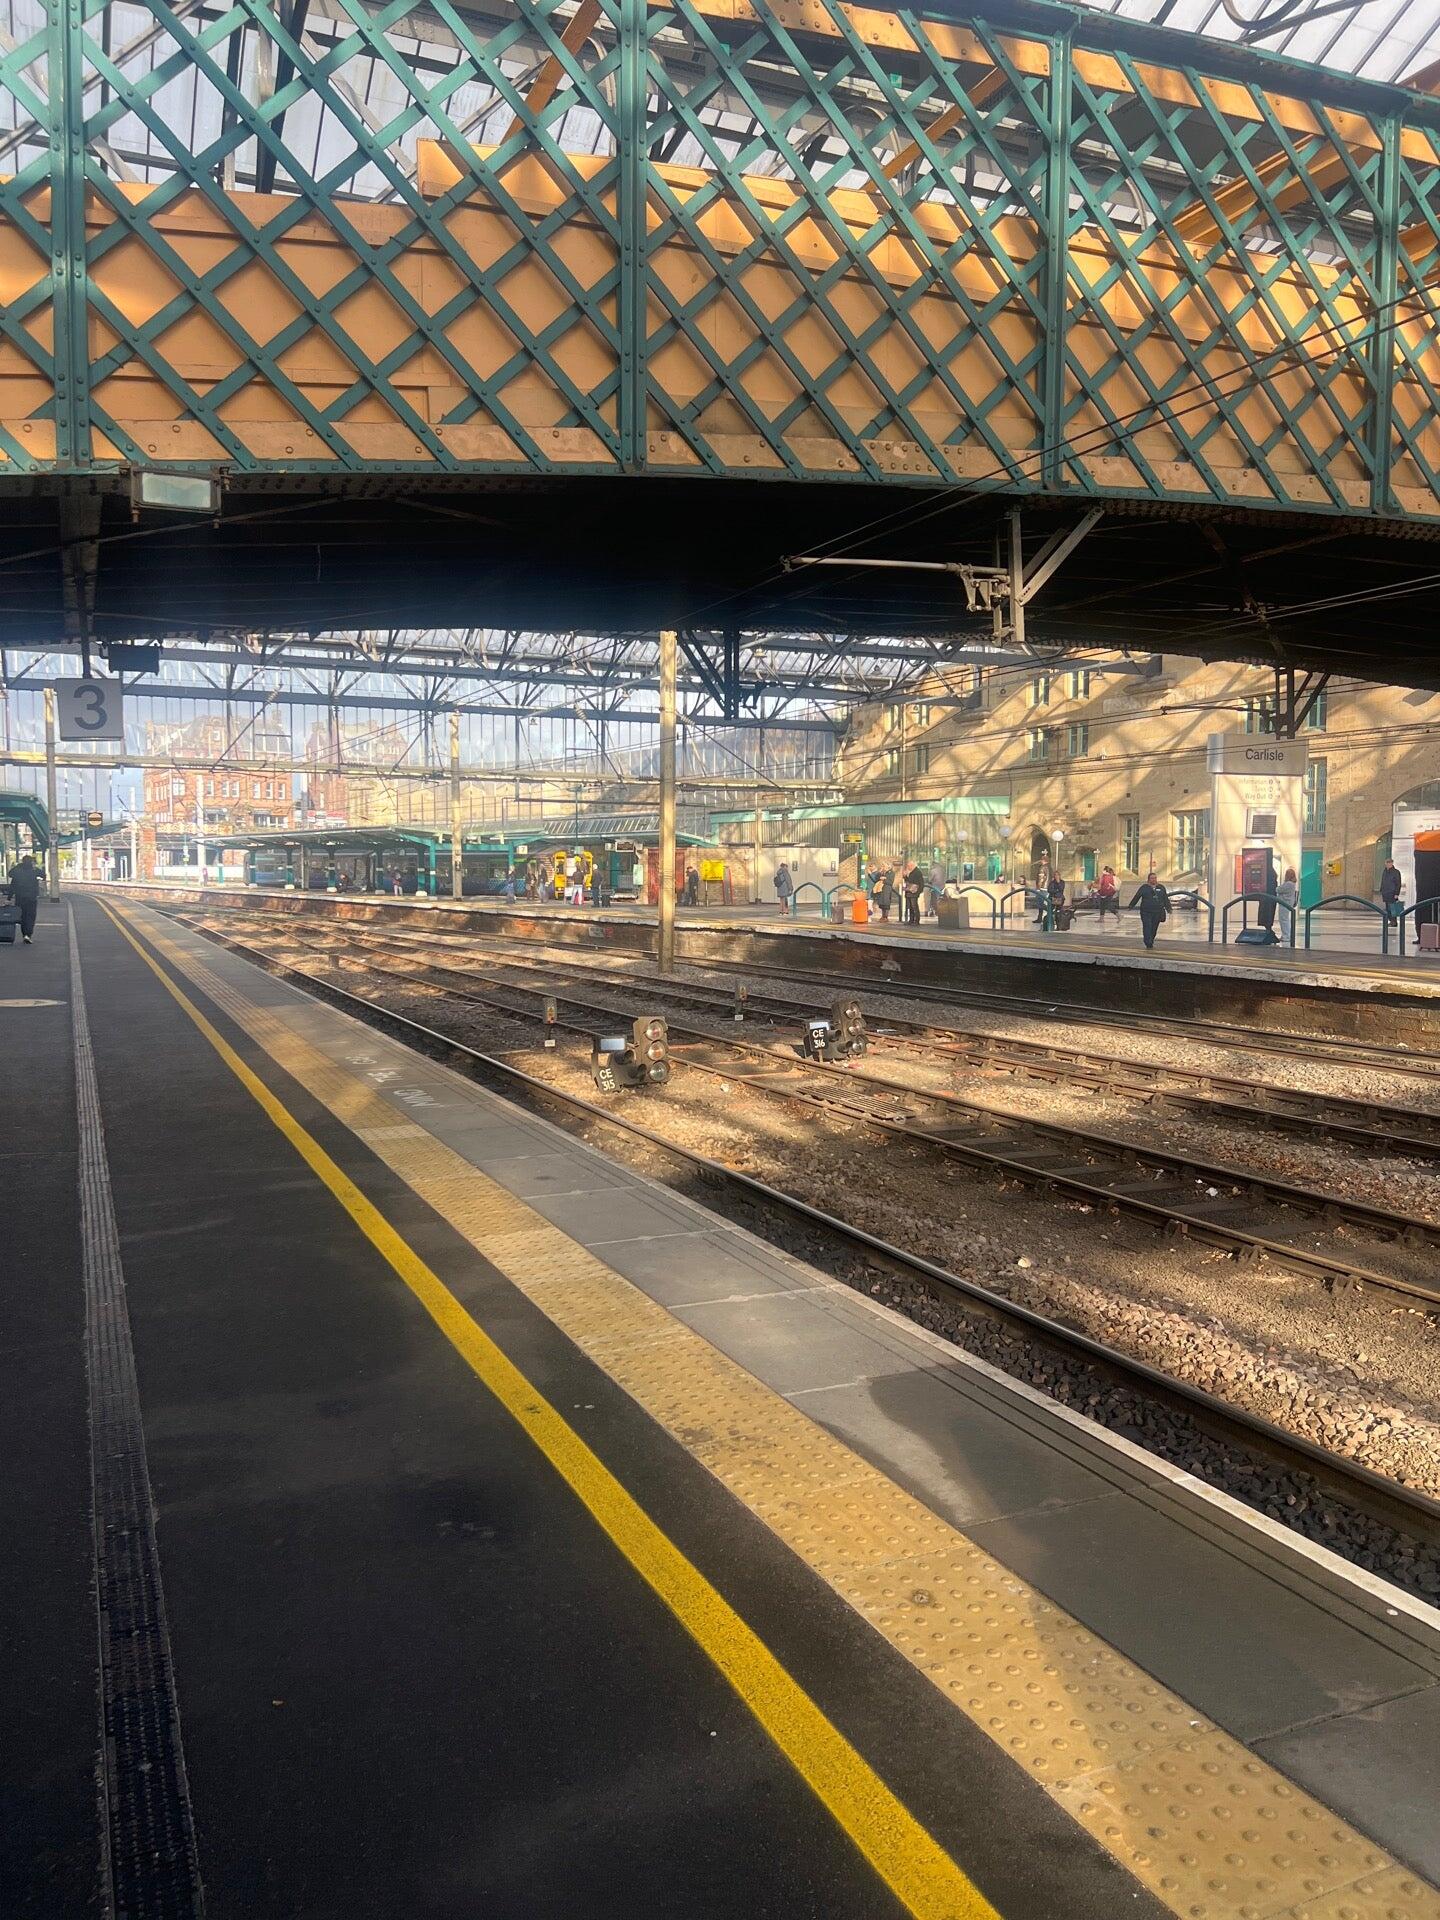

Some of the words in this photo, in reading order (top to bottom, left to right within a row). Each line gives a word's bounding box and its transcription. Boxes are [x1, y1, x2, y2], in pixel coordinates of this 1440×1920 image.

[74, 685, 107, 730] 3
[1245, 748, 1284, 761] Carlisle
[812, 1029, 824, 1038] CE
[814, 1038, 826, 1049] 316
[599, 1068, 613, 1079] CE
[601, 1080, 616, 1091] 315
